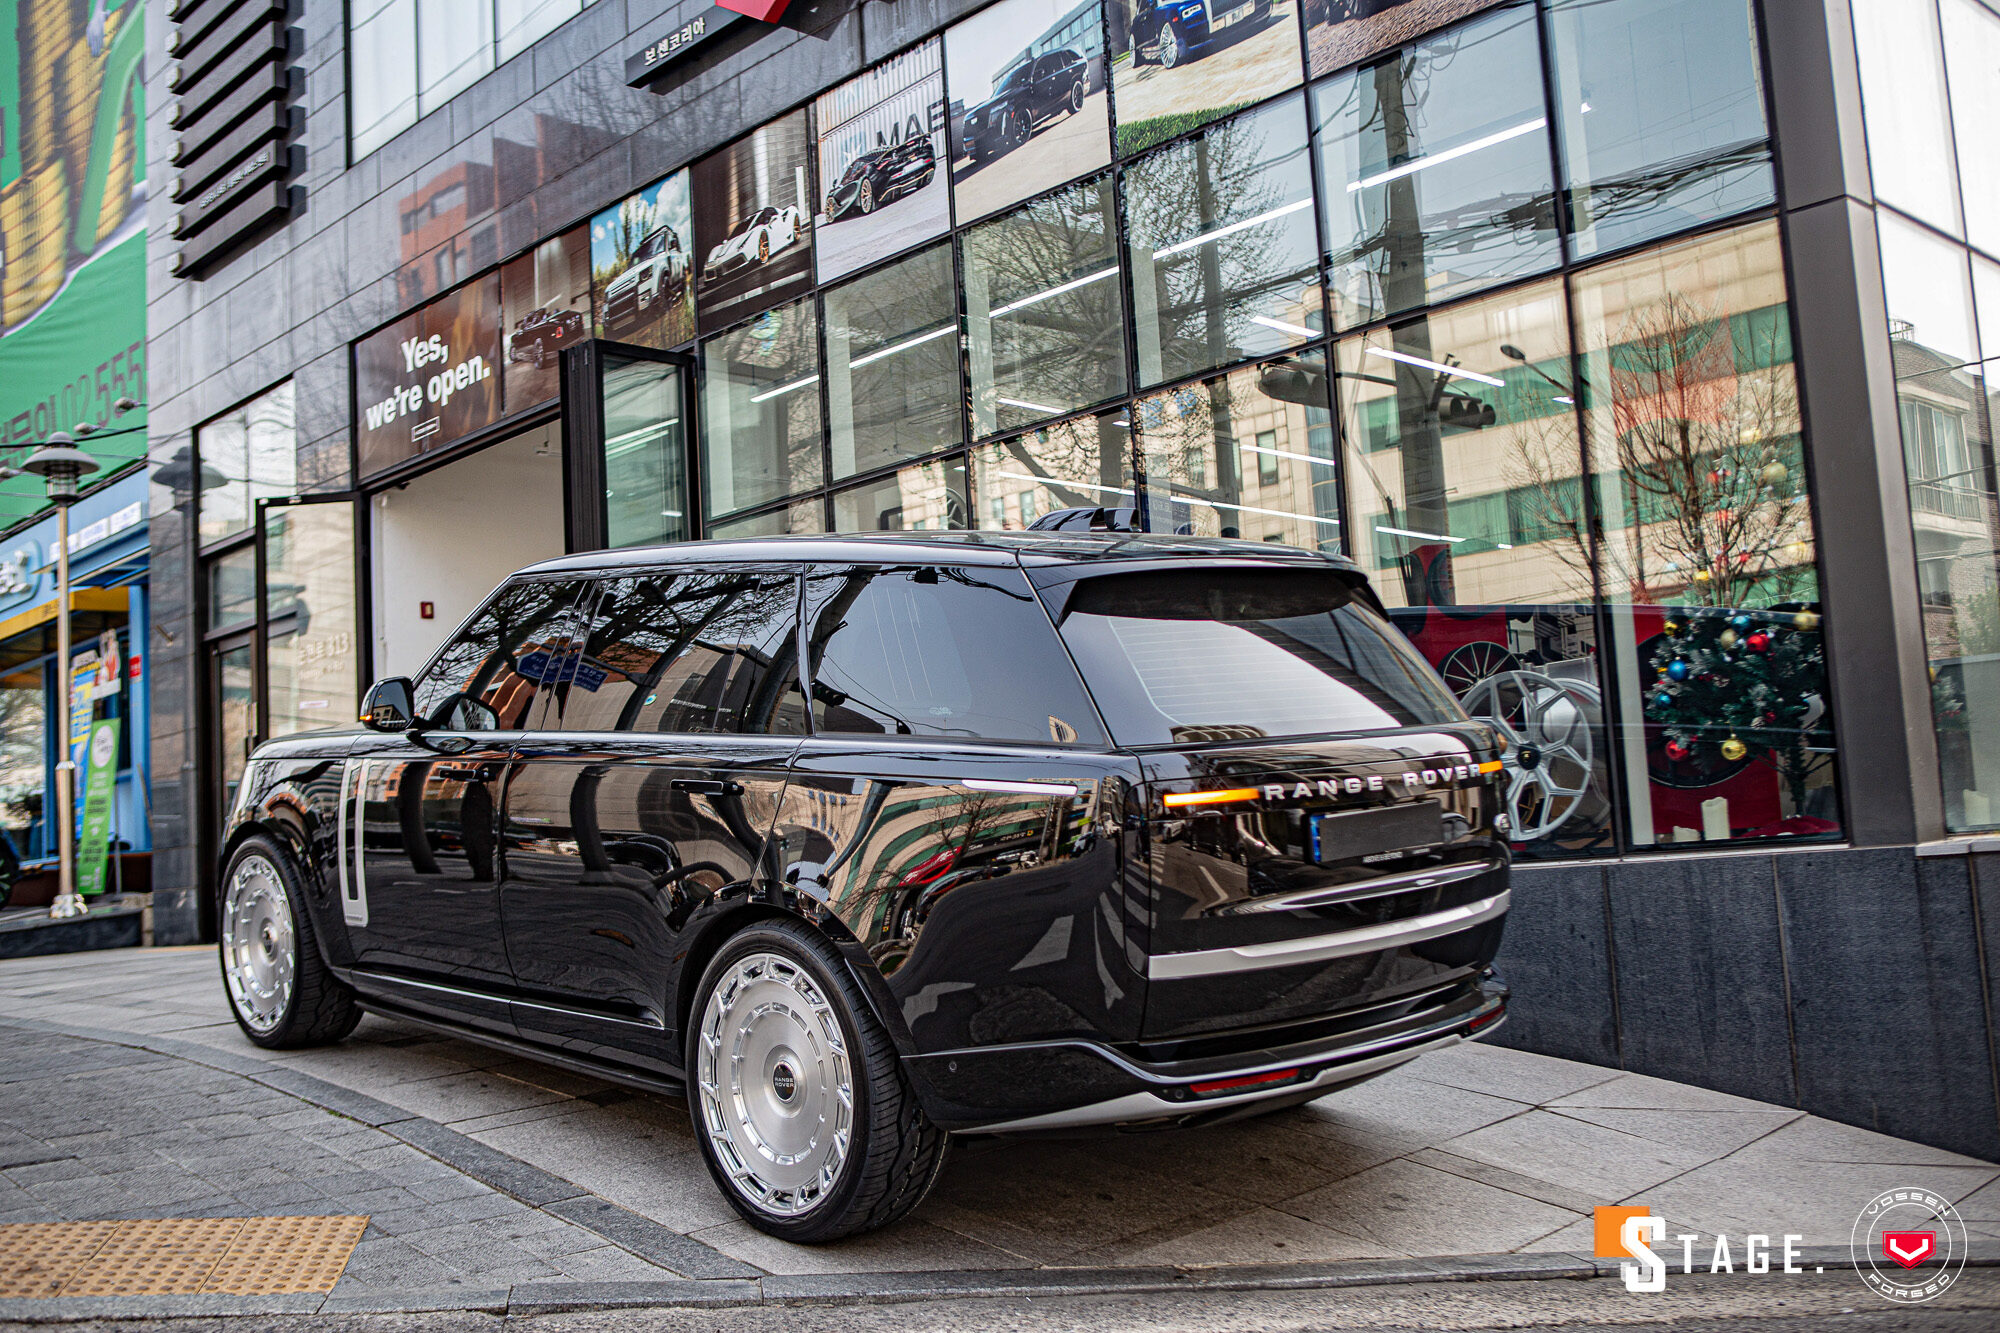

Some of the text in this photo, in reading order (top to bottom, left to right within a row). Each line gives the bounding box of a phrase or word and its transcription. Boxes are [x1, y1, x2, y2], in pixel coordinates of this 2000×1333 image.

[644, 16, 705, 66] 보센코리아
[401, 334, 448, 373] Yes,
[366, 355, 490, 431] we're open.
[1264, 763, 1481, 801] RANGE ROVER
